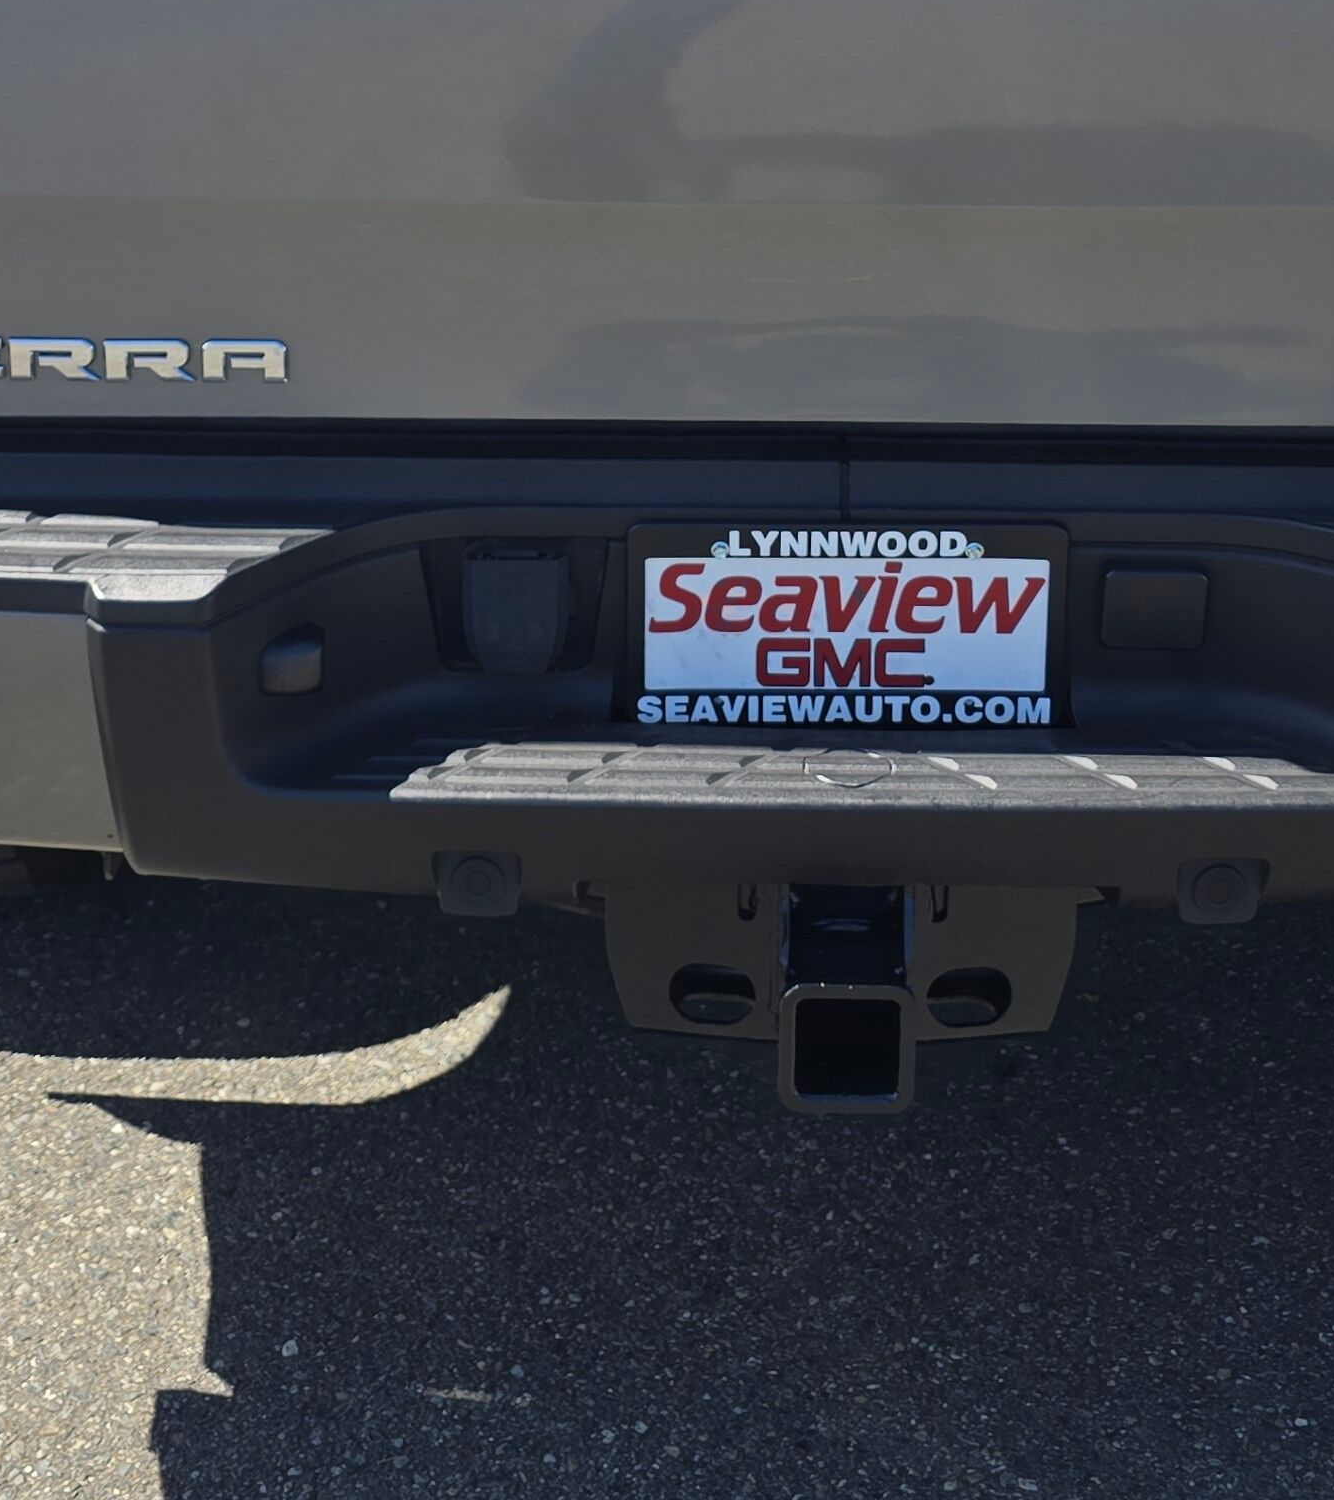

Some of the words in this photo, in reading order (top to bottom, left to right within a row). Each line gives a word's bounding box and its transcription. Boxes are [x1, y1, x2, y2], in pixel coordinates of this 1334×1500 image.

[729, 530, 968, 558] LYNNWOOD
[649, 561, 1046, 634] Seaview
[755, 637, 929, 688] GMC
[637, 694, 1051, 725] SEAVIEWAUTO.COM
